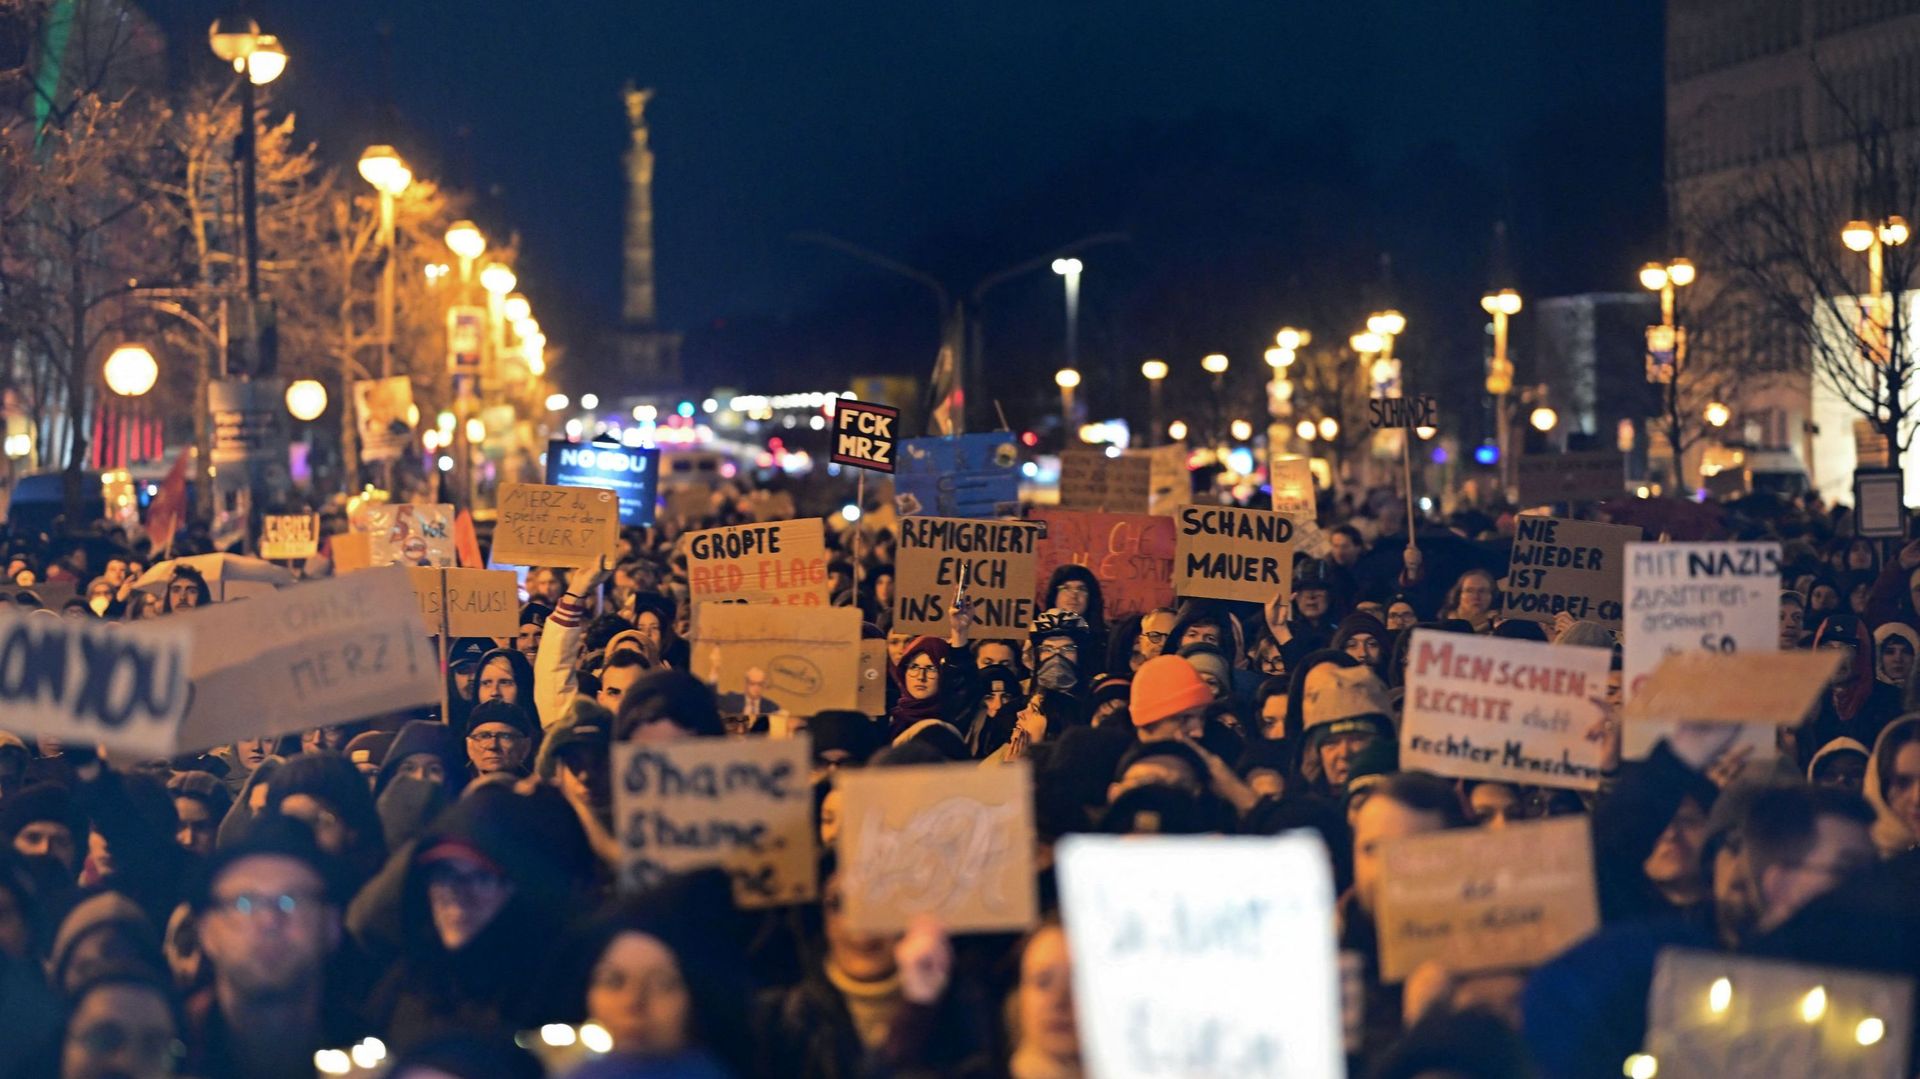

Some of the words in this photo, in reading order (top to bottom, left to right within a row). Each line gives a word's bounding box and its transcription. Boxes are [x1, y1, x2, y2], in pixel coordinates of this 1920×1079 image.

[840, 408, 893, 438] FCK
[1369, 394, 1437, 428] SCHANDE
[838, 434, 892, 464] MRZ
[504, 487, 567, 509] MERZ
[902, 518, 1038, 554] REMIGRIERT
[1182, 508, 1294, 543] SCHAND
[1517, 519, 1559, 543] NIE
[1187, 553, 1280, 584] MAUER
[1512, 544, 1604, 571] WIEDER
[1634, 551, 1681, 577] MIT
[1688, 549, 1782, 579] NAZIS
[692, 563, 743, 595] RED
[758, 557, 825, 591] FLAG
[936, 557, 1007, 589] EUCH
[1509, 568, 1547, 590] IST
[449, 589, 507, 613] RAUS!
[900, 594, 944, 622] INS
[73, 632, 181, 729] YOU
[1414, 686, 1511, 724] RECHTE
[1411, 733, 1499, 763] rechter
